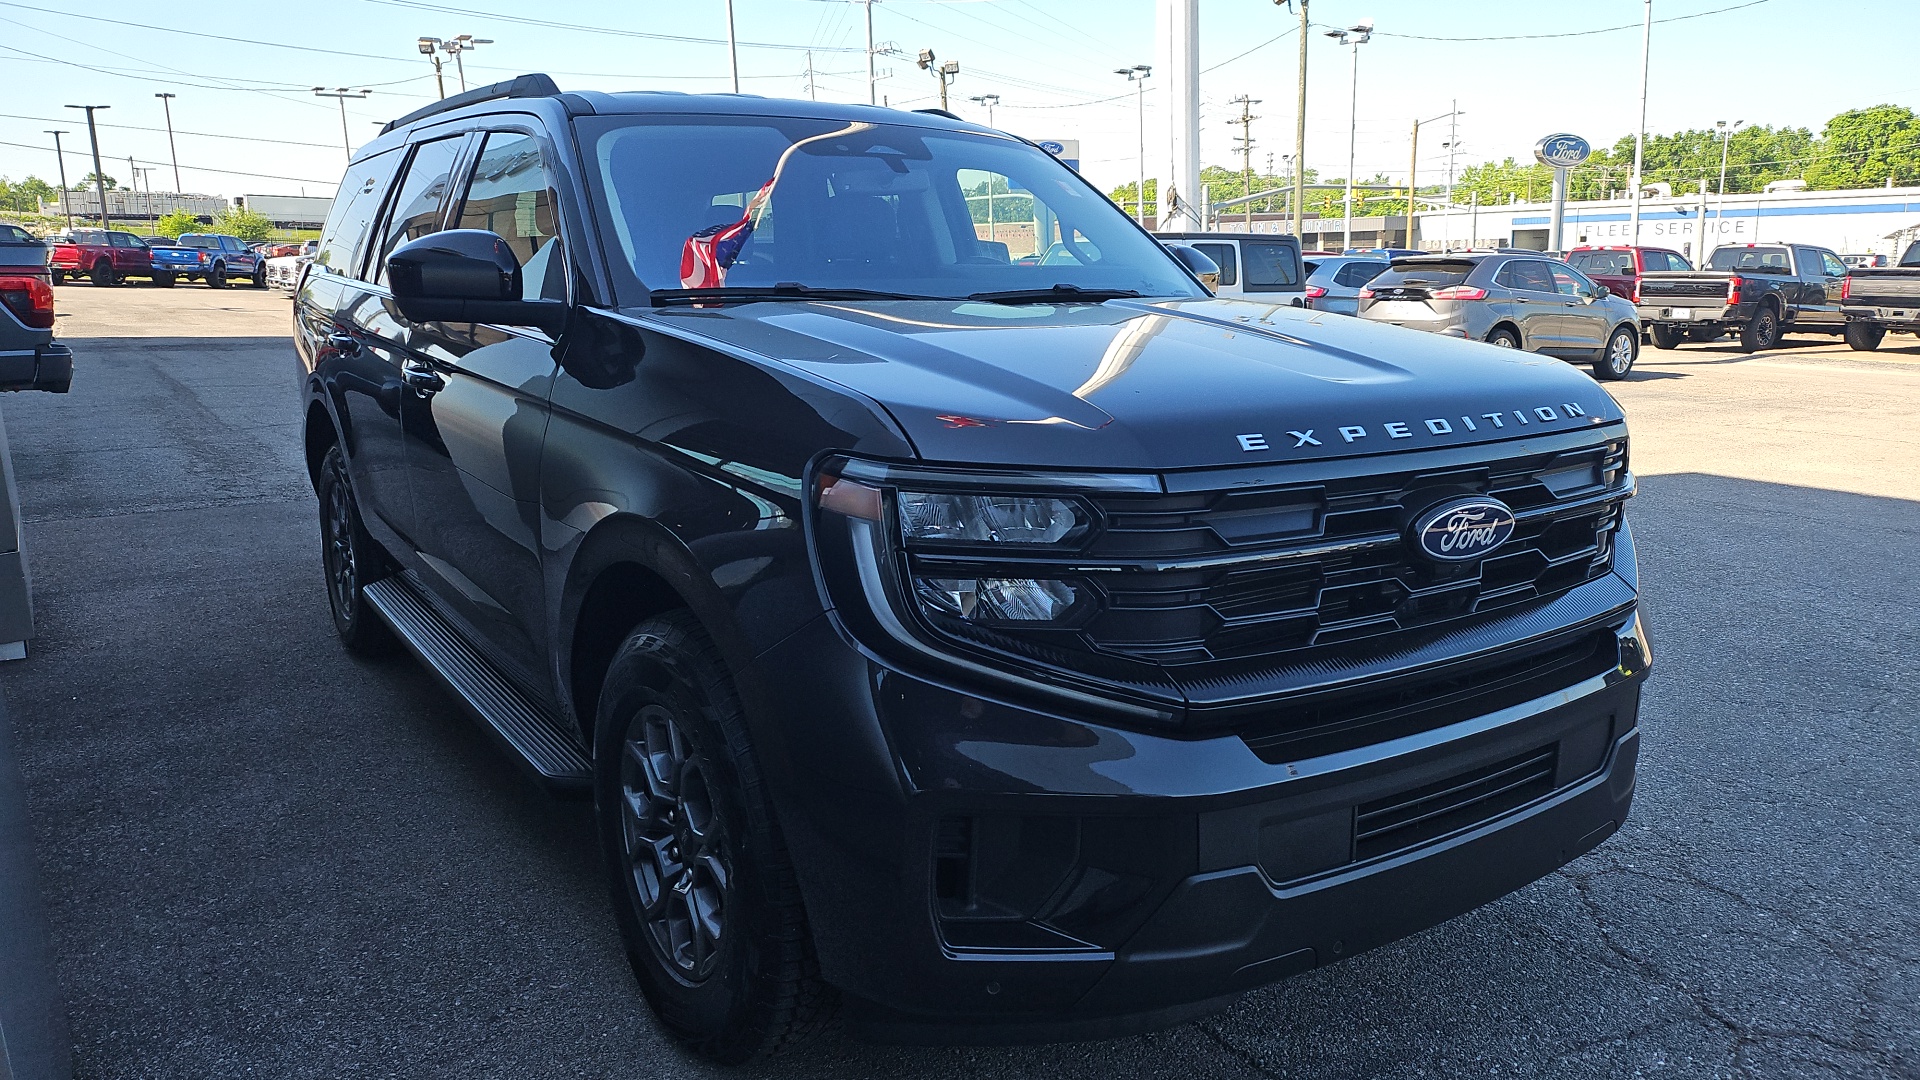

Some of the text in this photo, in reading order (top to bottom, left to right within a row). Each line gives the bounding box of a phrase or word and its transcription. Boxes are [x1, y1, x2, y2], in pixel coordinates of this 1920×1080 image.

[1552, 140, 1583, 160] Ford
[1286, 220, 1346, 234] CUNTR
[1583, 221, 1745, 237] FLEET SERICE
[1235, 402, 1586, 452] EXPEDITION
[1440, 511, 1498, 552] Ford
